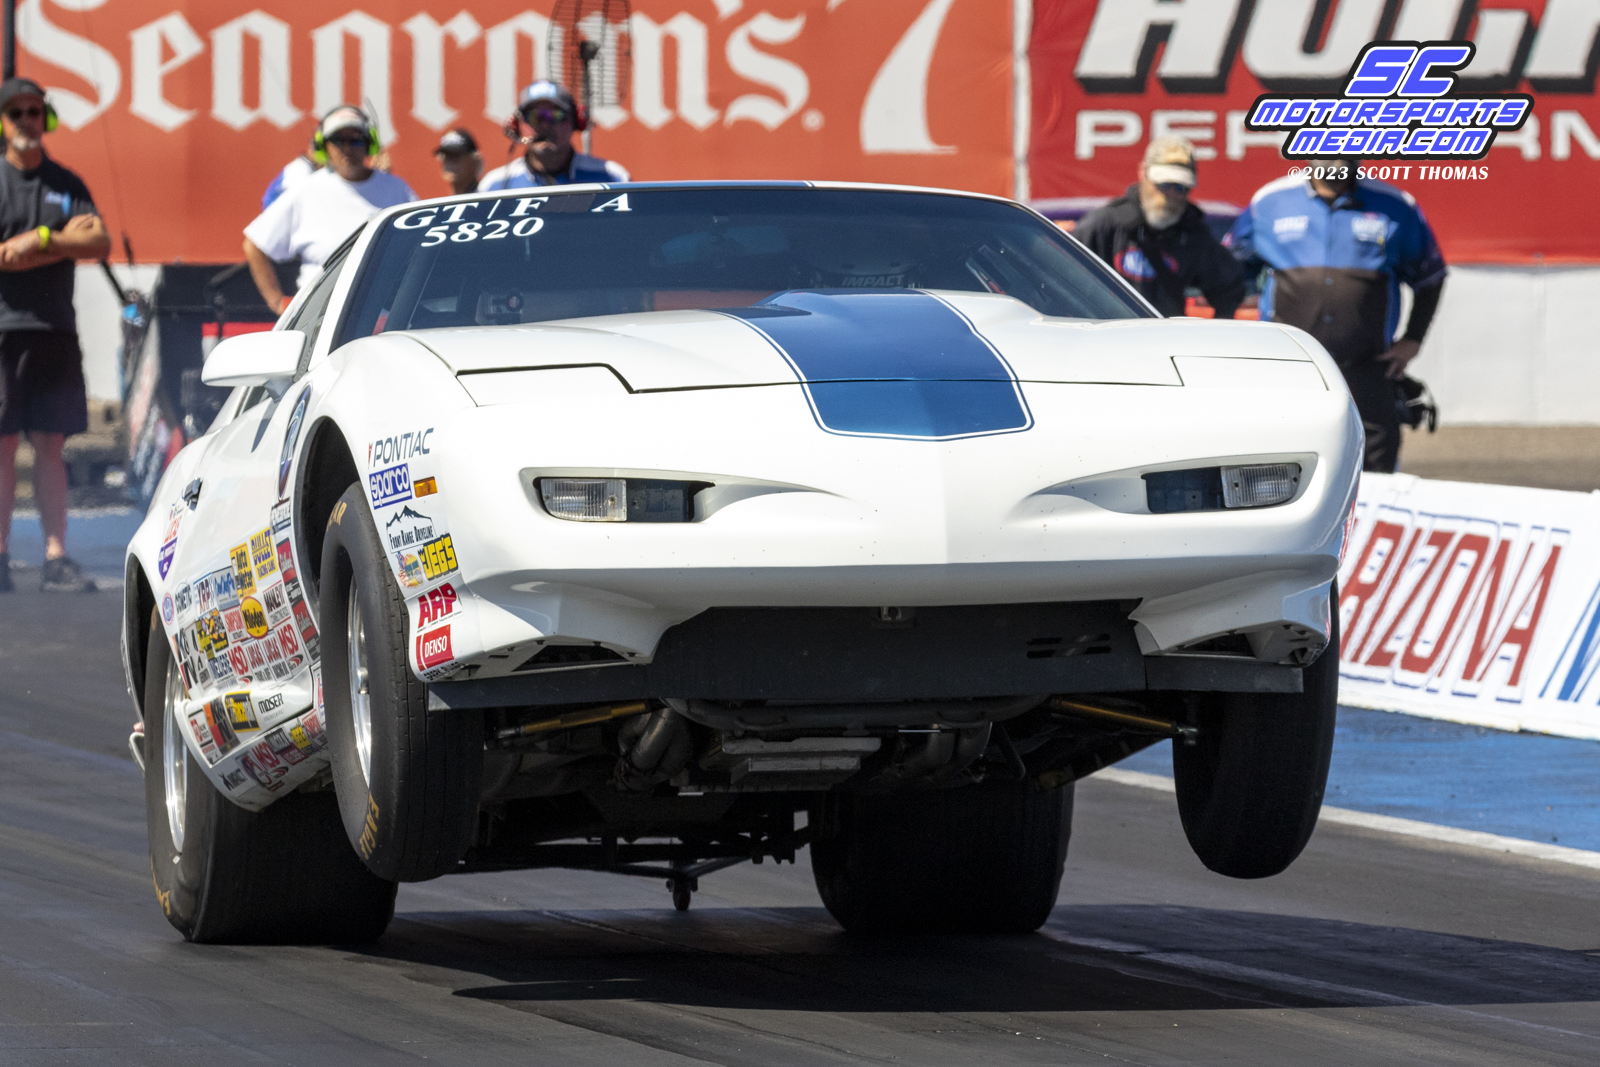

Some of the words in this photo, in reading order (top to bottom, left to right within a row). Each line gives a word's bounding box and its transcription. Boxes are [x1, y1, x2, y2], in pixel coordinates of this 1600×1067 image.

[15, 0, 810, 146] Seagram's
[591, 192, 633, 213] A
[420, 216, 545, 247] 5820
[841, 274, 905, 287] IMPACT
[373, 427, 435, 467] PONTIAC
[369, 468, 411, 503] sparco
[422, 534, 458, 580] JEG'S
[418, 582, 458, 629] ARP
[1339, 517, 1563, 688] RIZONA
[276, 624, 300, 658] MSD
[424, 635, 448, 658] DENSO
[226, 645, 249, 676] MSD
[258, 692, 285, 714] MOSER
[251, 741, 281, 773] MSD
